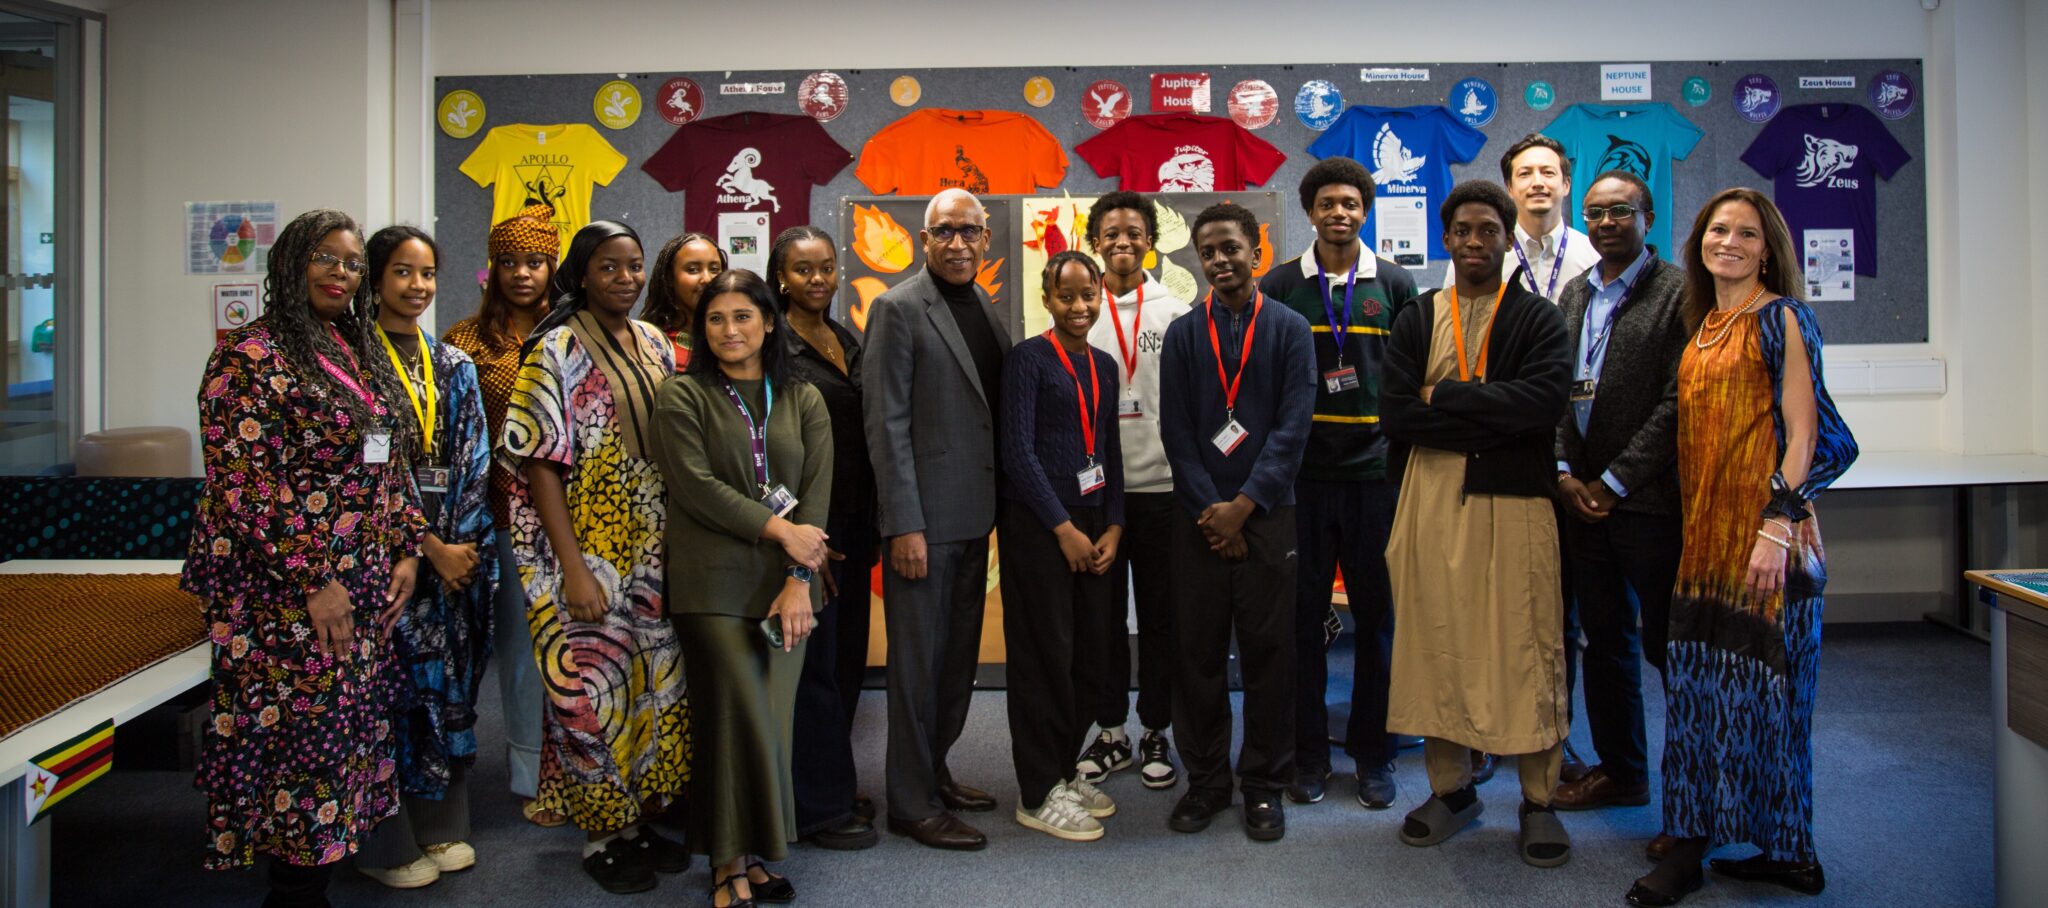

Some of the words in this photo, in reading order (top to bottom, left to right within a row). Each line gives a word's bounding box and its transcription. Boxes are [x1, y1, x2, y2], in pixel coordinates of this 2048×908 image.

[1366, 72, 1398, 80] Minerva
[1400, 72, 1425, 80] House
[1606, 72, 1647, 80] NEPTUNE
[1161, 78, 1201, 90] Jupiter
[1611, 86, 1643, 94] HOUSE
[1174, 144, 1209, 156] Jupiter
[520, 154, 569, 164] APOLLO
[940, 177, 965, 187] Hera
[1827, 175, 1858, 189] Zeus
[1387, 184, 1426, 194] Minerva
[717, 194, 752, 203] Athena
